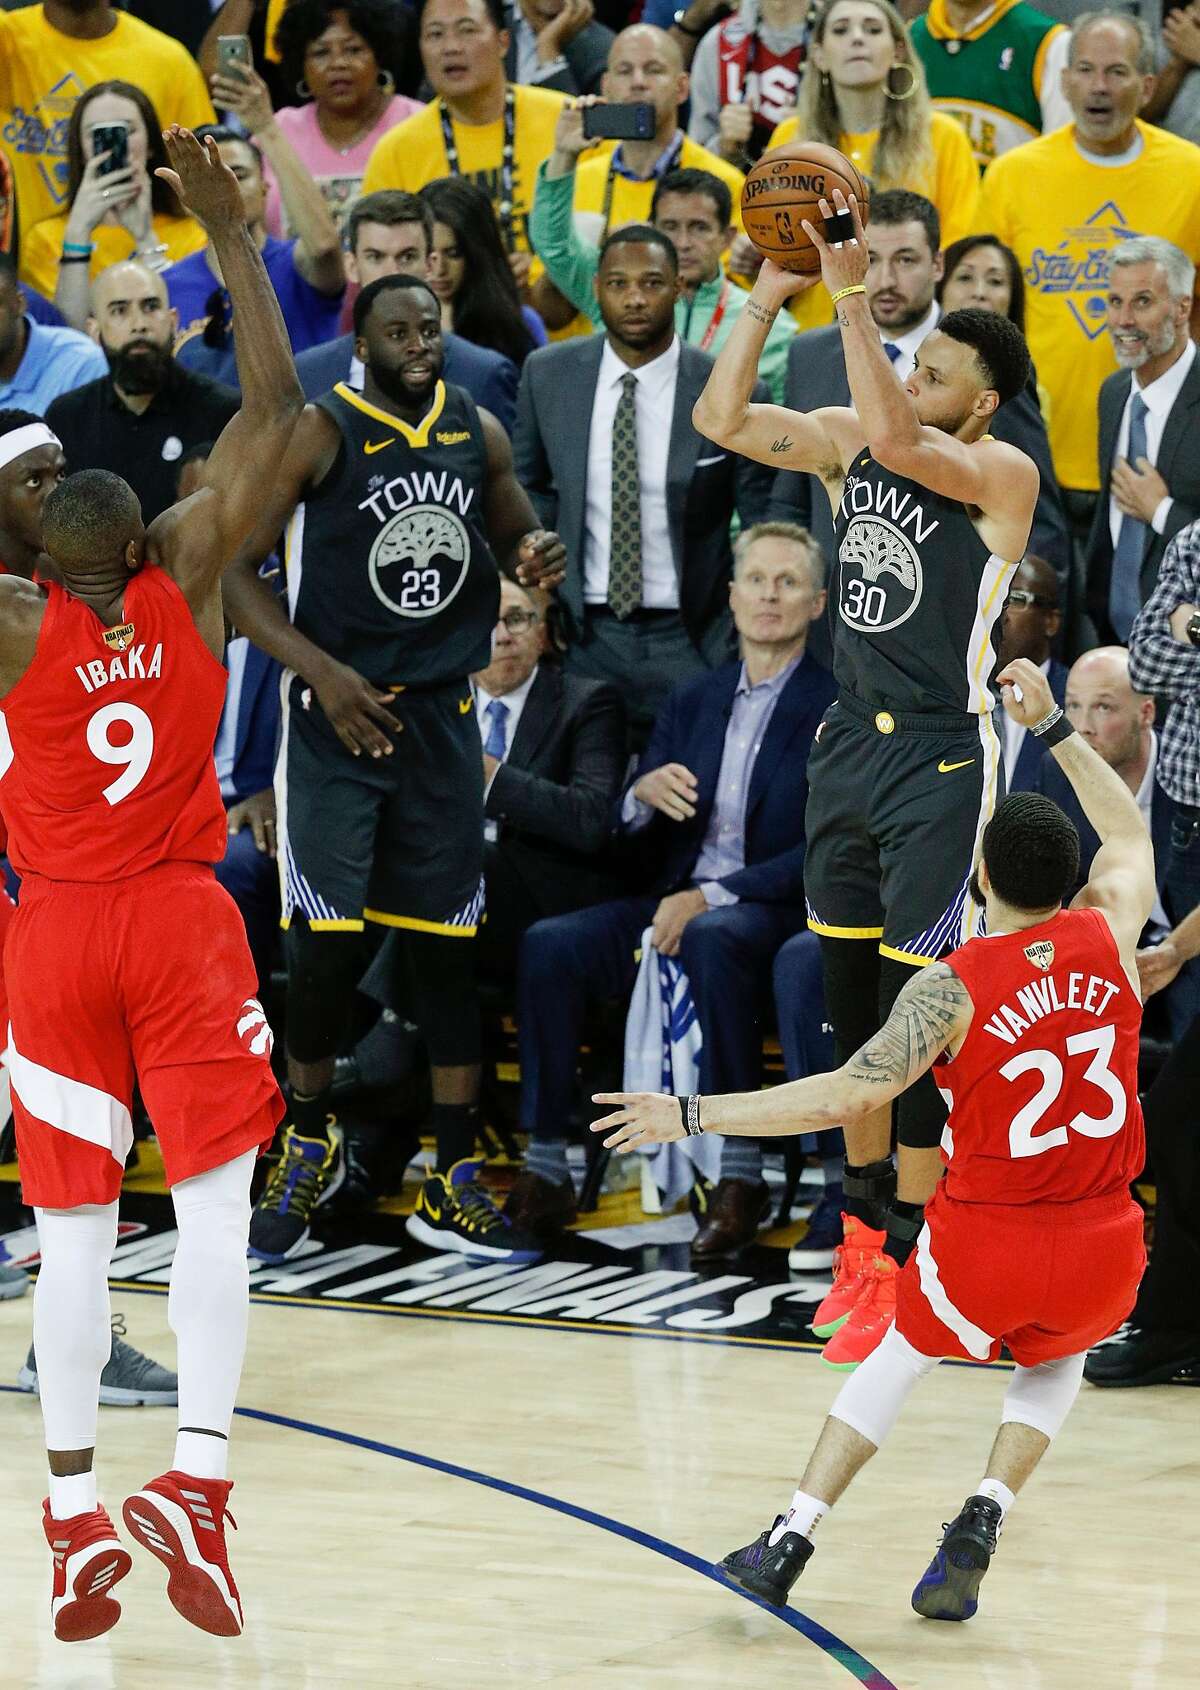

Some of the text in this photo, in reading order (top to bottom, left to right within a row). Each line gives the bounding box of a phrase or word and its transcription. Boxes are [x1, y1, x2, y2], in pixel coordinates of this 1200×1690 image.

[745, 175, 824, 202] SPALDING
[358, 471, 474, 523] TOWN
[400, 568, 441, 609] 23
[844, 579, 887, 626] 30
[104, 624, 134, 643] NBA FINALS
[75, 643, 163, 694] IBAKA
[86, 701, 154, 806] 9
[1025, 942, 1053, 959] NBA FINALS
[983, 972, 1121, 1045] VANVLEET
[998, 1023, 1128, 1159] 23
[320, 1252, 832, 1329] FINALS
